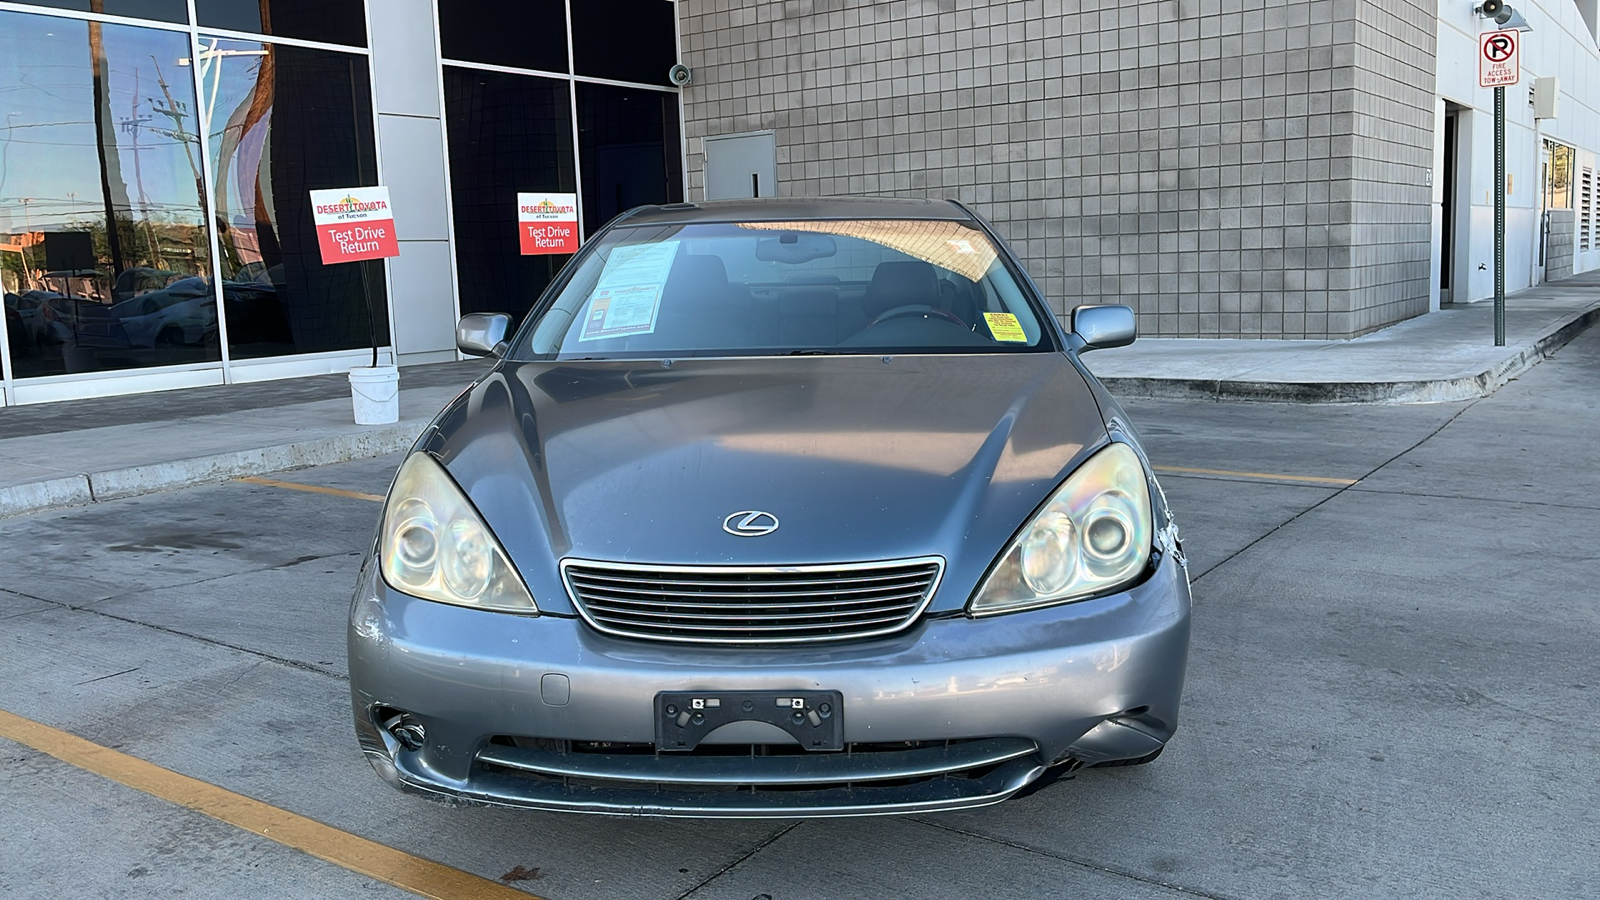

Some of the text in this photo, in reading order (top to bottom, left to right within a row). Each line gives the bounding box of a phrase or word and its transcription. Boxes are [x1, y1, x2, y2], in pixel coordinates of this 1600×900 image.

[1487, 69, 1512, 77] ACCESS
[316, 201, 388, 214] DESERT TOYOTA
[521, 205, 574, 213] DESERT TOYOTA
[328, 227, 386, 242] Test Drive
[527, 226, 570, 237] Test Drive
[340, 241, 380, 254] Return
[535, 237, 565, 248] Return
